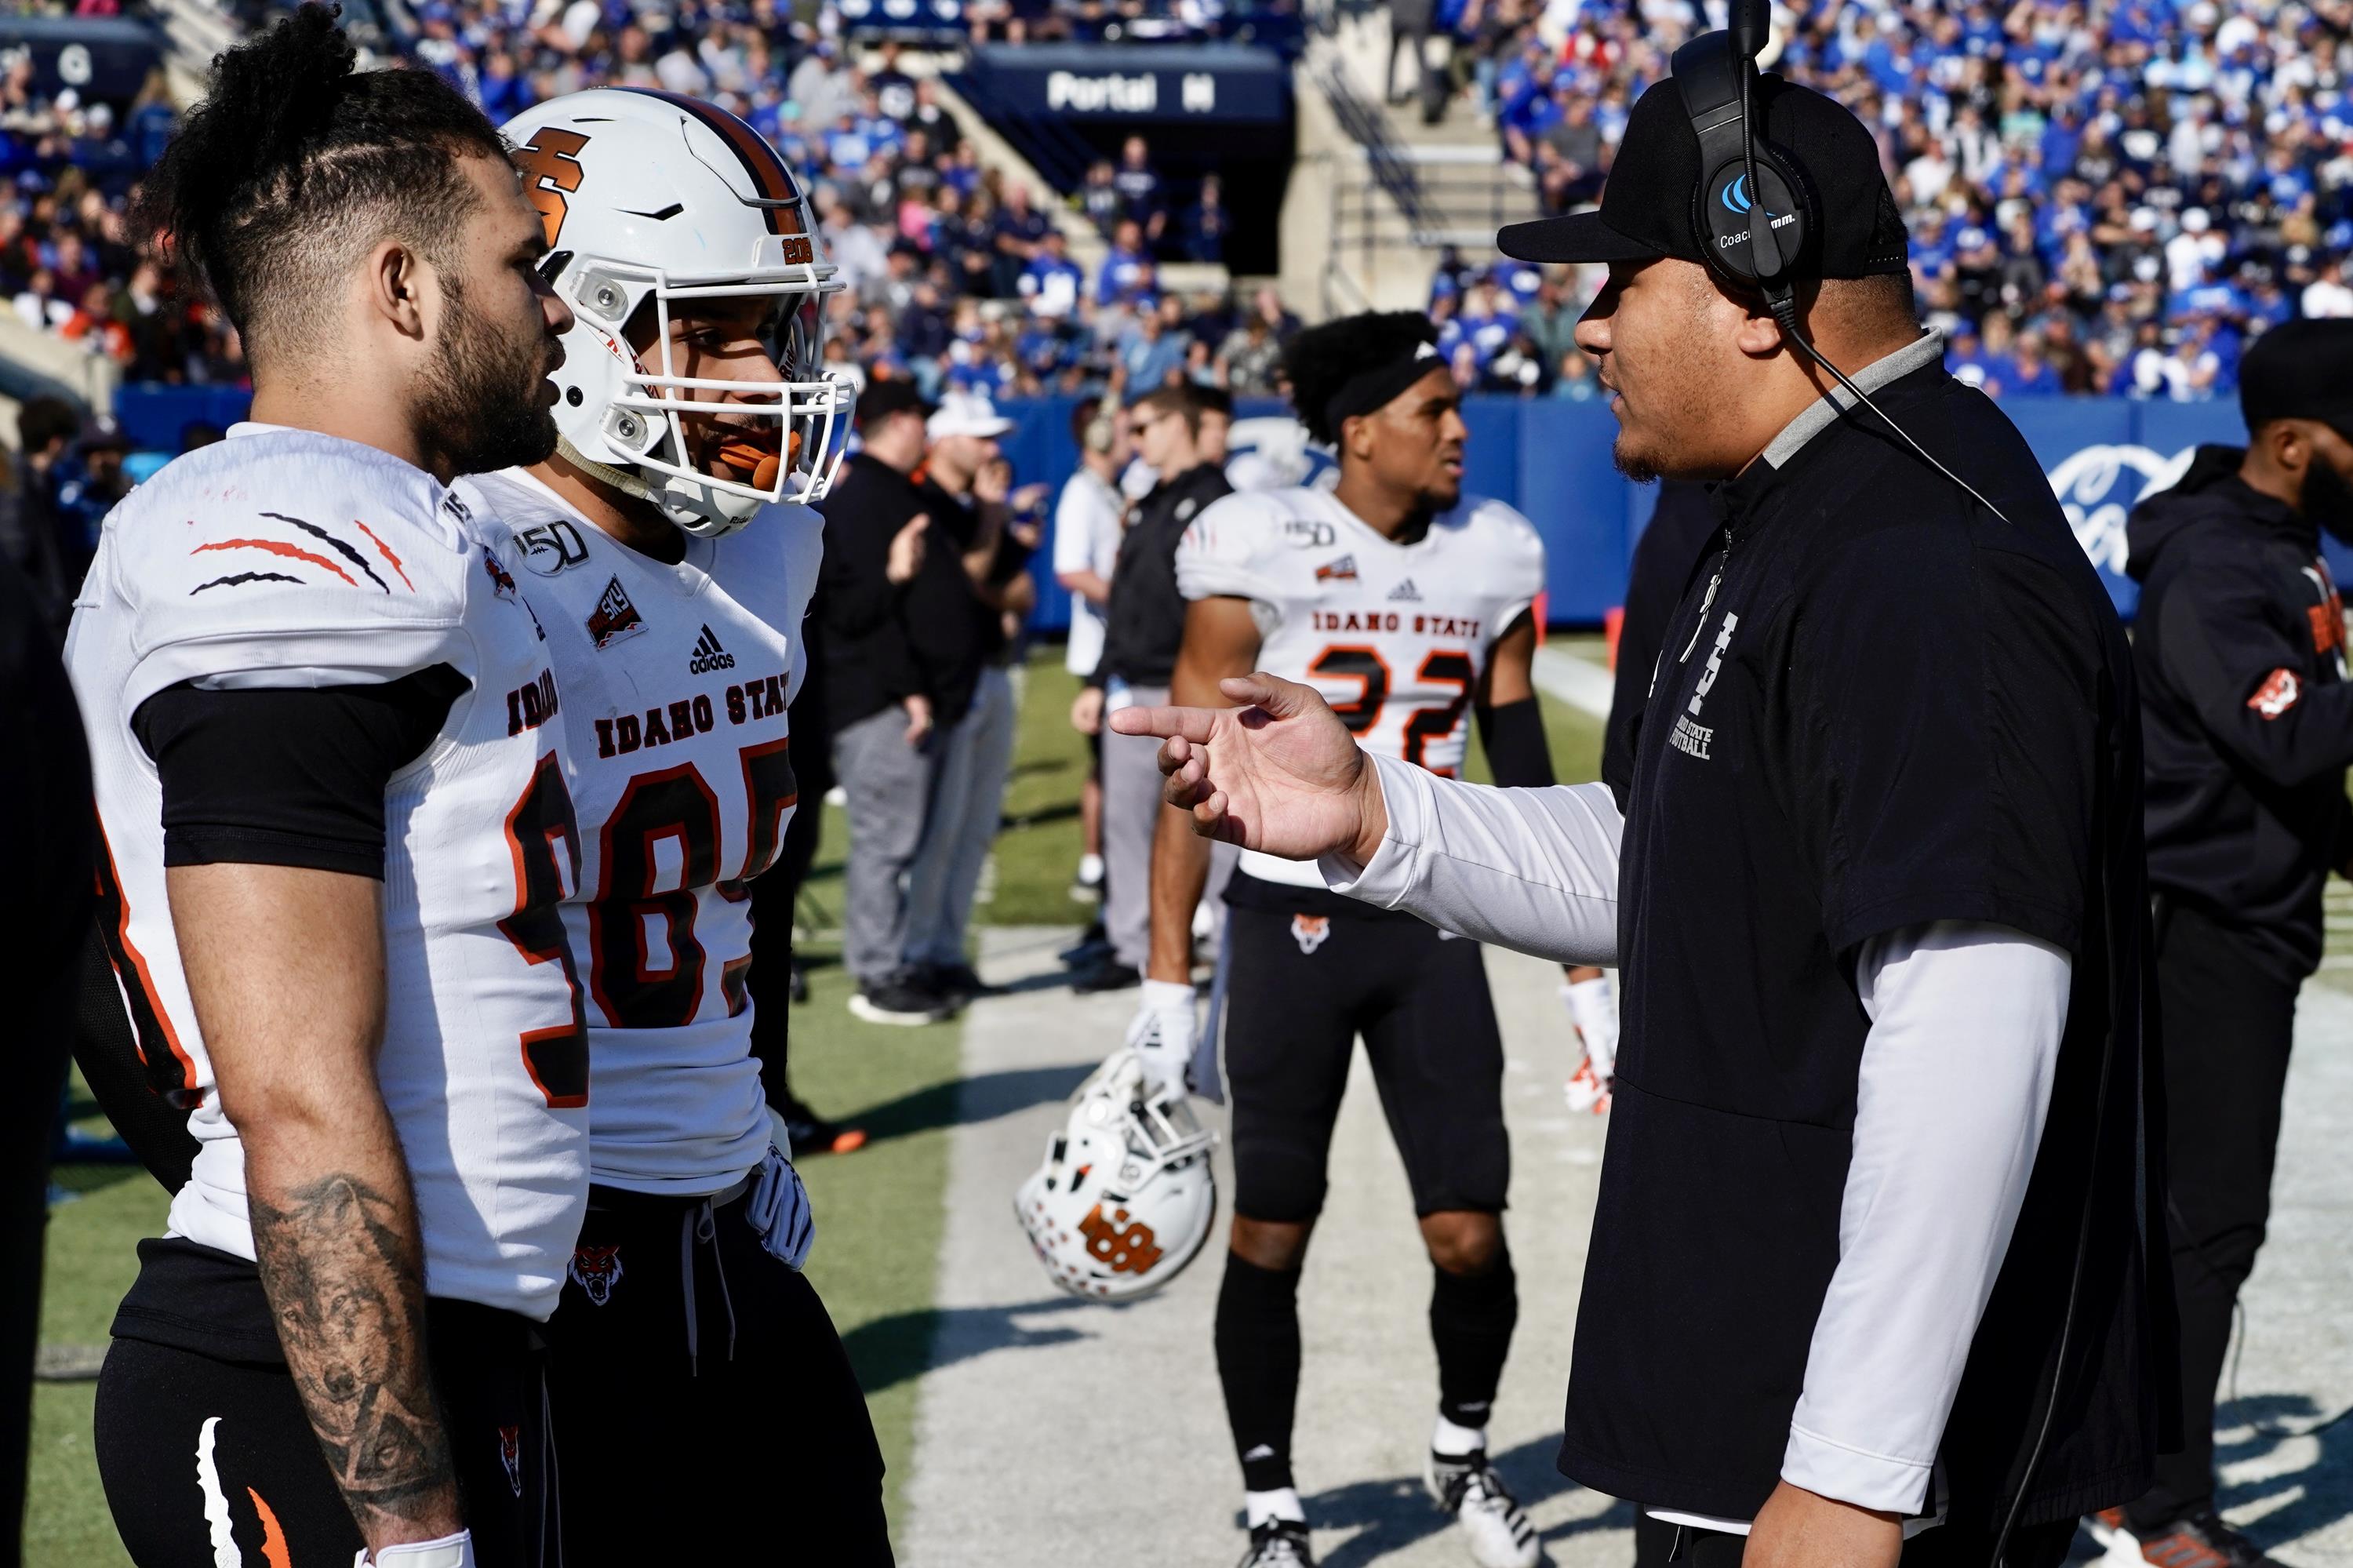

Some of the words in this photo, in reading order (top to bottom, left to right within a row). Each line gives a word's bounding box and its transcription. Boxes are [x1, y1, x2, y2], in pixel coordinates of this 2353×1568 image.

[1047, 70, 1157, 112] Portal
[1182, 72, 1215, 113] H
[782, 238, 813, 264] 208
[601, 583, 629, 620] SKY
[1313, 611, 1398, 631] IDAHO
[689, 653, 735, 675] adidas
[595, 694, 715, 759] IDAHO
[1686, 721, 1714, 743] STATE
[1669, 727, 1710, 760] FOOTBALL
